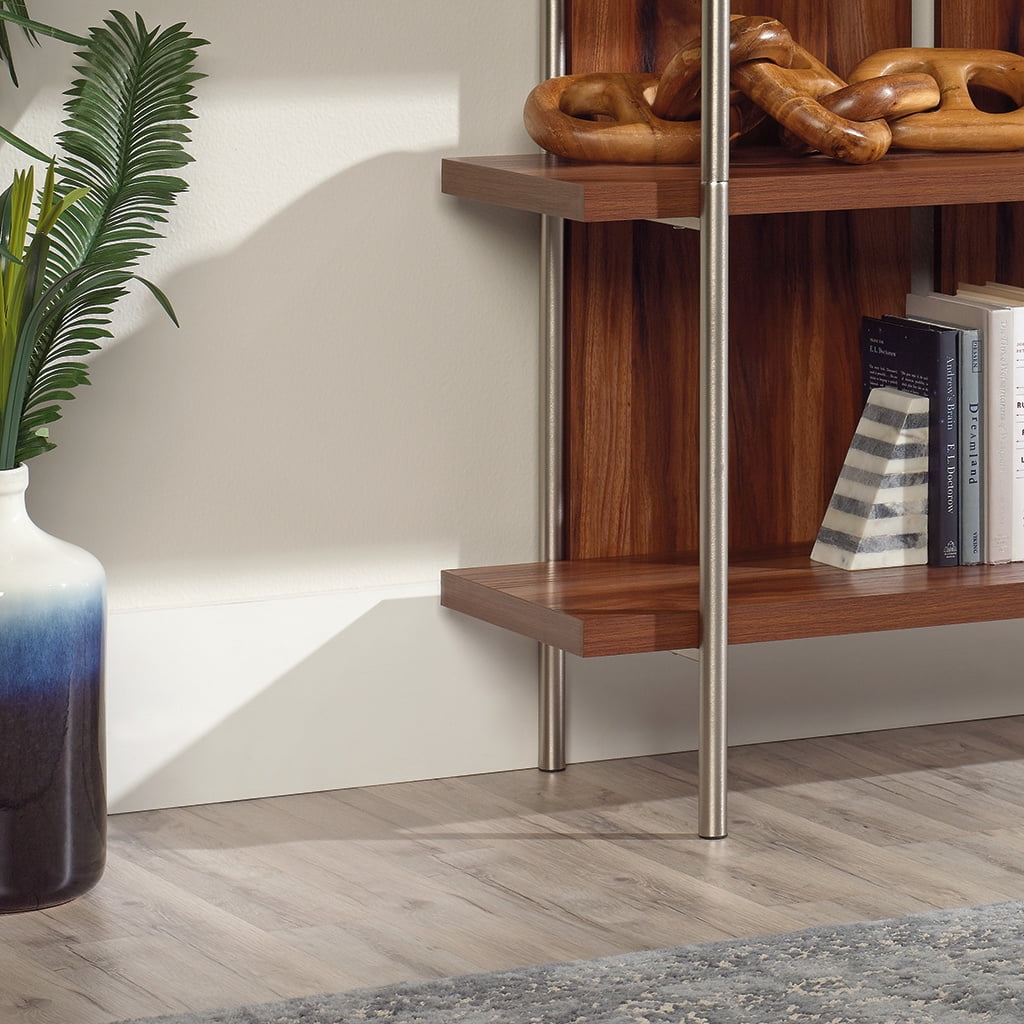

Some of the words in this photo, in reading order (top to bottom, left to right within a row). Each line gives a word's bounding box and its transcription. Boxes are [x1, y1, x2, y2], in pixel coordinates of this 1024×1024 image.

[946, 356, 955, 401] Andrew's
[946, 404, 956, 430] Brain
[946, 455, 955, 465] L.
[947, 443, 956, 454] E.
[946, 466, 956, 514] Doctorow
